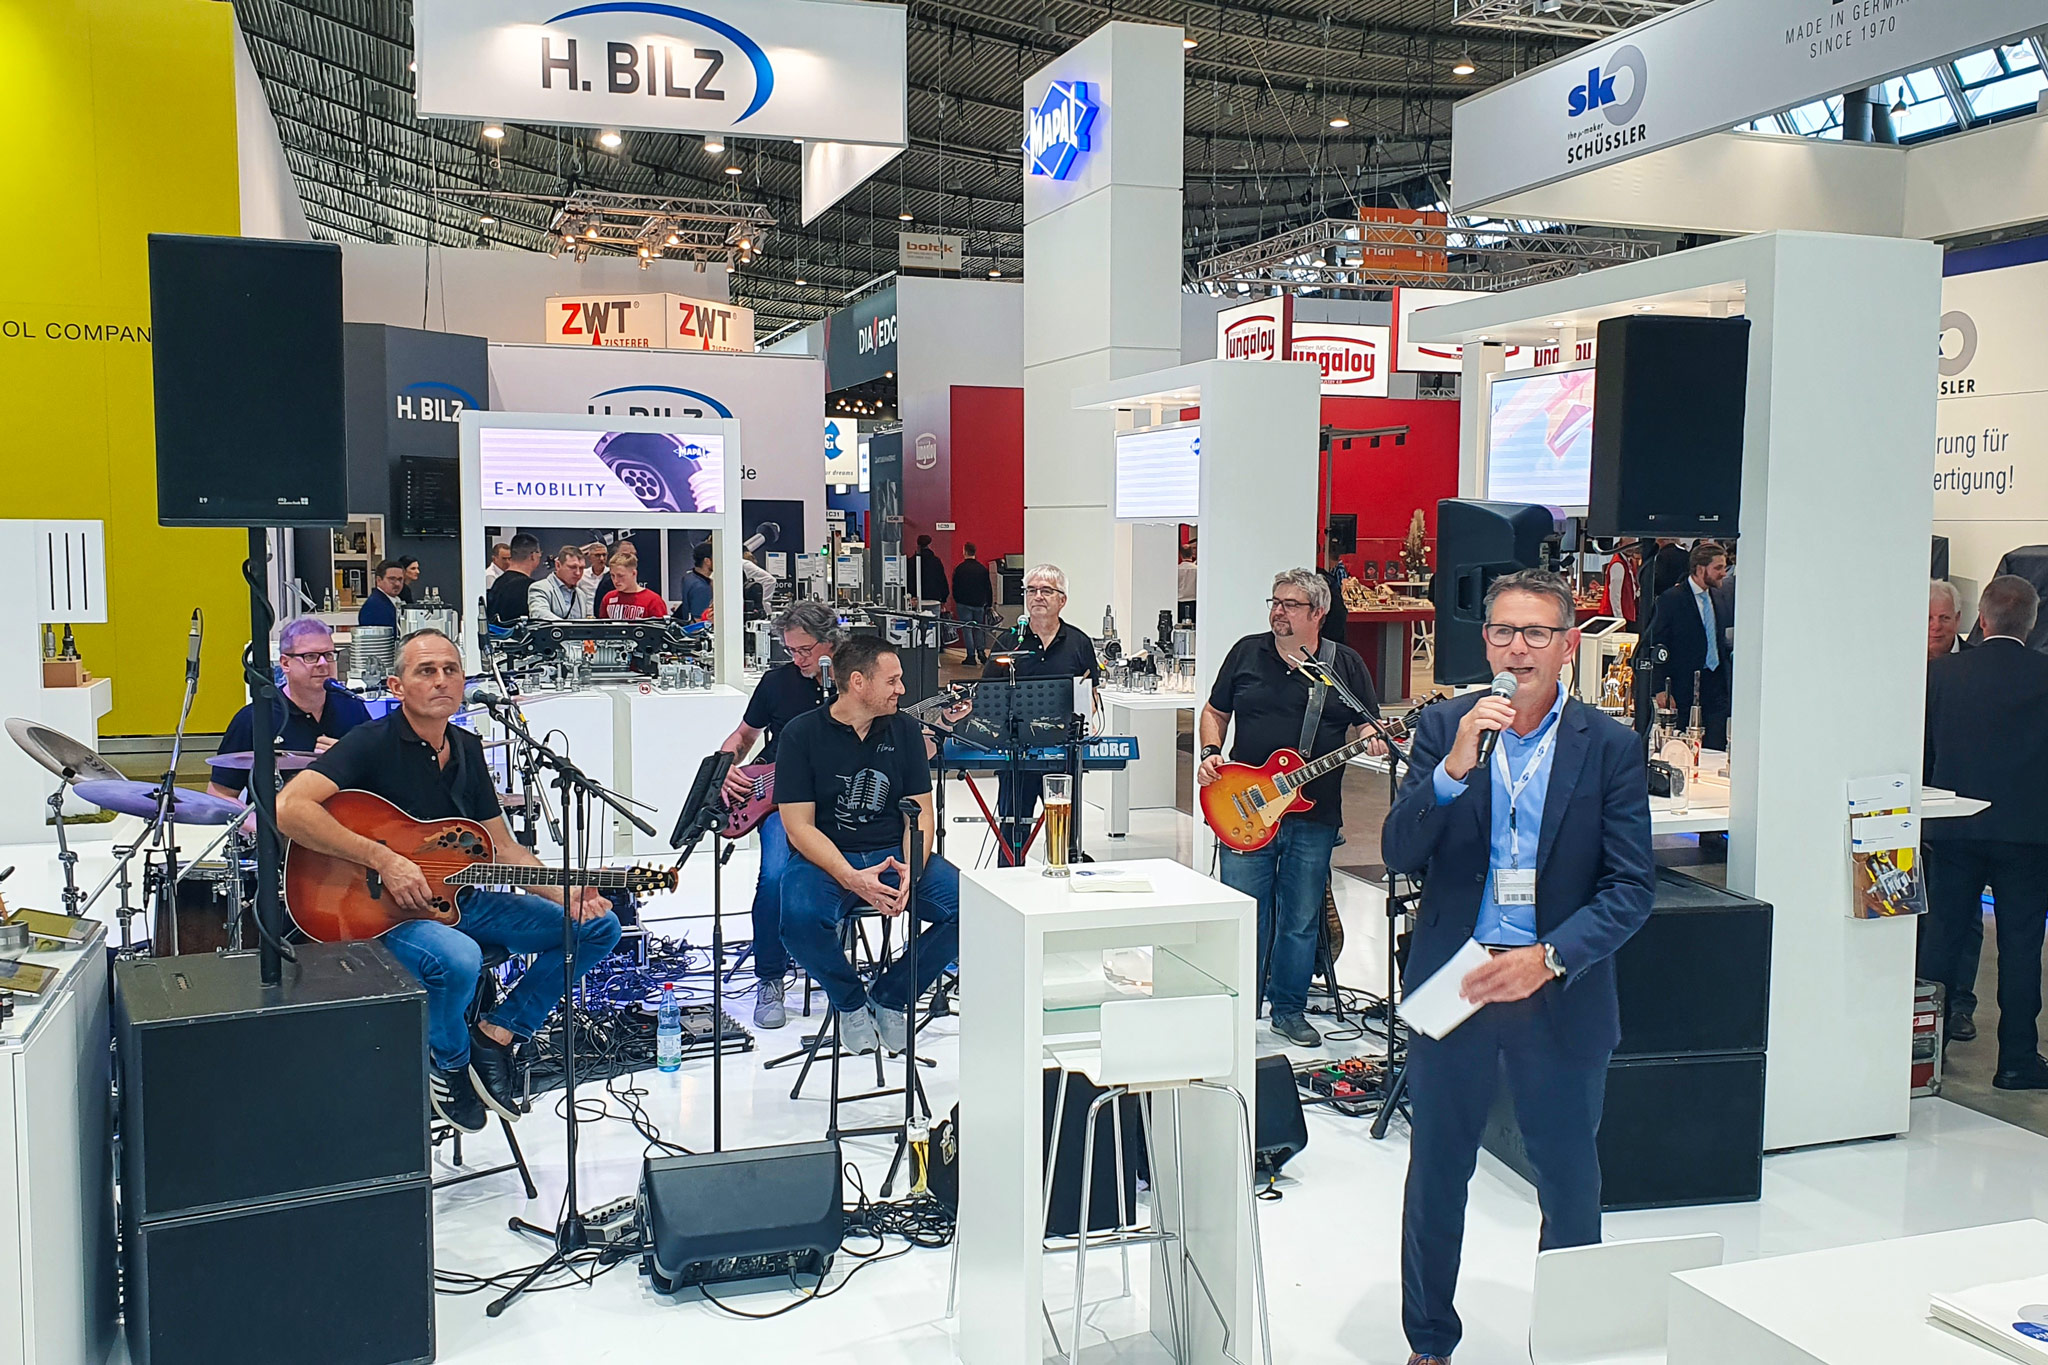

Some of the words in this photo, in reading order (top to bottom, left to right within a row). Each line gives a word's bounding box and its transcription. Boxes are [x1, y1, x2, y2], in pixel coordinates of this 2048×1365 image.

[1785, 18, 1822, 44] MADE
[1830, 10, 1844, 29] IN
[1853, 0, 1909, 21] GERM
[1810, 30, 1852, 58] SINCE
[1861, 16, 1896, 40] 1970
[541, 37, 592, 92] H.
[607, 41, 725, 101] BILZ
[1567, 132, 1577, 140] the
[1567, 124, 1647, 164] SCHÜSSLER
[2, 320, 36, 338] OL
[45, 322, 152, 343] COMPAN
[1225, 327, 1275, 360] Tungaloy
[1938, 379, 1976, 395] SLER
[396, 395, 417, 420] H.
[420, 397, 463, 423] BILZ
[1936, 434, 1976, 458] rung
[1982, 428, 2009, 453] für
[494, 482, 606, 498] E-MOBILITY
[1932, 464, 2014, 495] ertigung!
[1089, 743, 1130, 757] KORG
